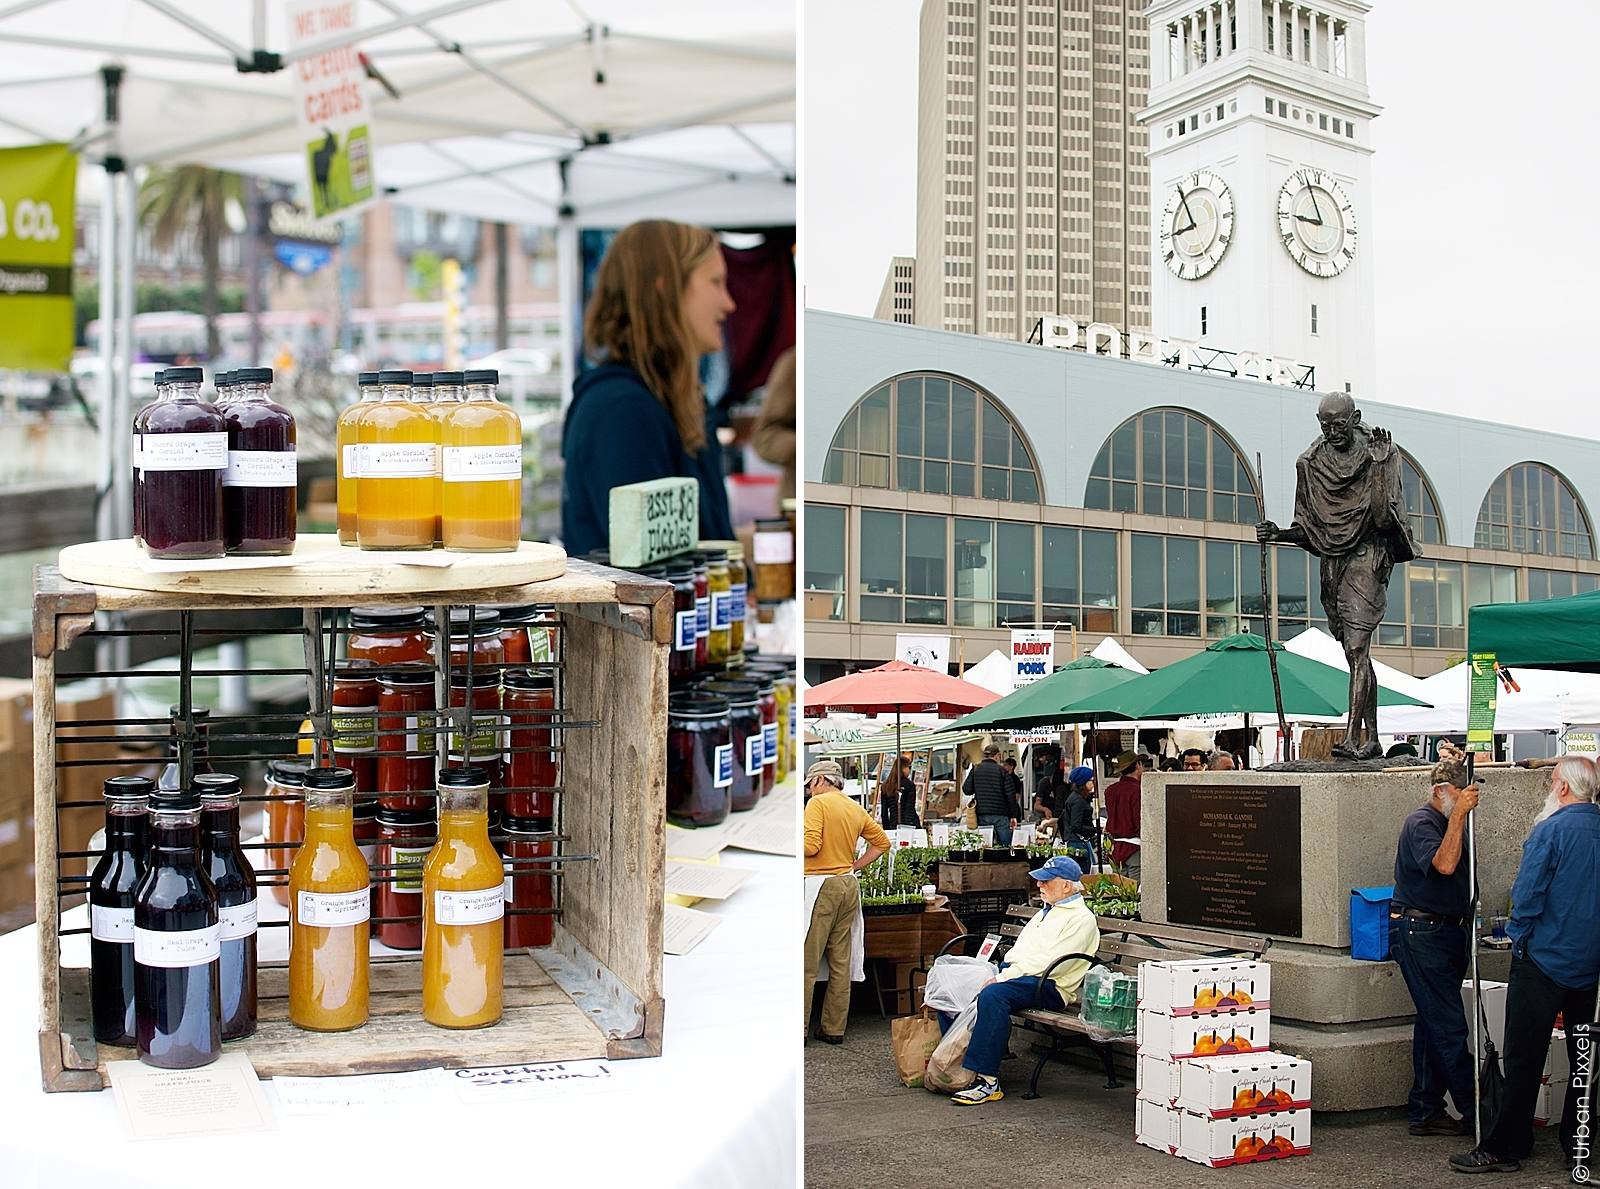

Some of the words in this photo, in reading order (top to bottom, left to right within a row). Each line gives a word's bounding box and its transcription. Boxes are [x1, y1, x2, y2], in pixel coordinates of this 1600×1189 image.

[647, 520, 690, 560] pickles
[1013, 643, 1051, 655] RABBIT
[1017, 661, 1046, 675] PORK
[334, 720, 363, 728] kitchen
[1012, 728, 1050, 736] SAUSAGE
[1567, 743, 1597, 752] ORANGES
[455, 1064, 566, 1079] Cocktail
